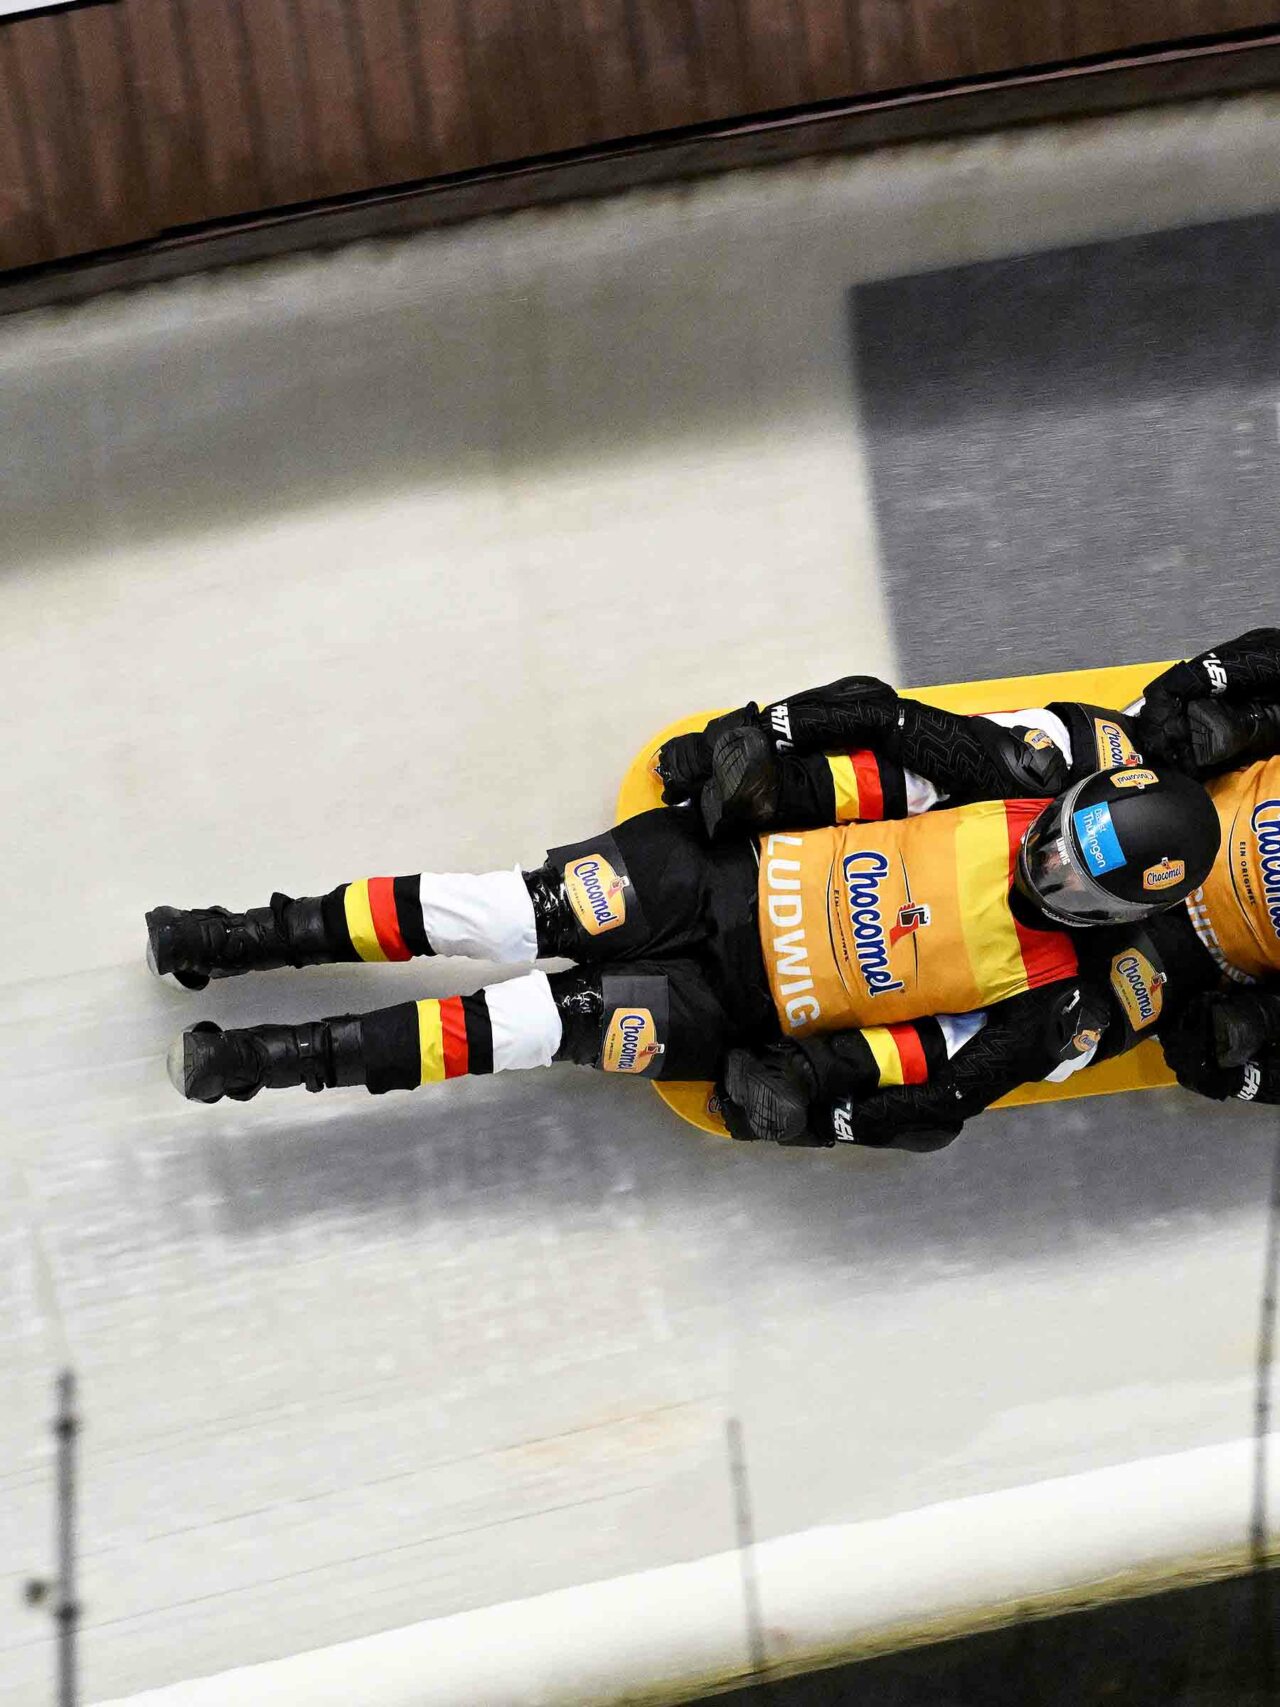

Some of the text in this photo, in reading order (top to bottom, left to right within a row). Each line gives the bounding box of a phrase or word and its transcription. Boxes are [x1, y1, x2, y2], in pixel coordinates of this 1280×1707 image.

[1082, 812, 1106, 869] Thüringen
[573, 861, 617, 926] Chocomel
[843, 851, 903, 997] Chocomel
[767, 833, 822, 1028] LUDWIG
[1116, 956, 1156, 1022] Chocomel
